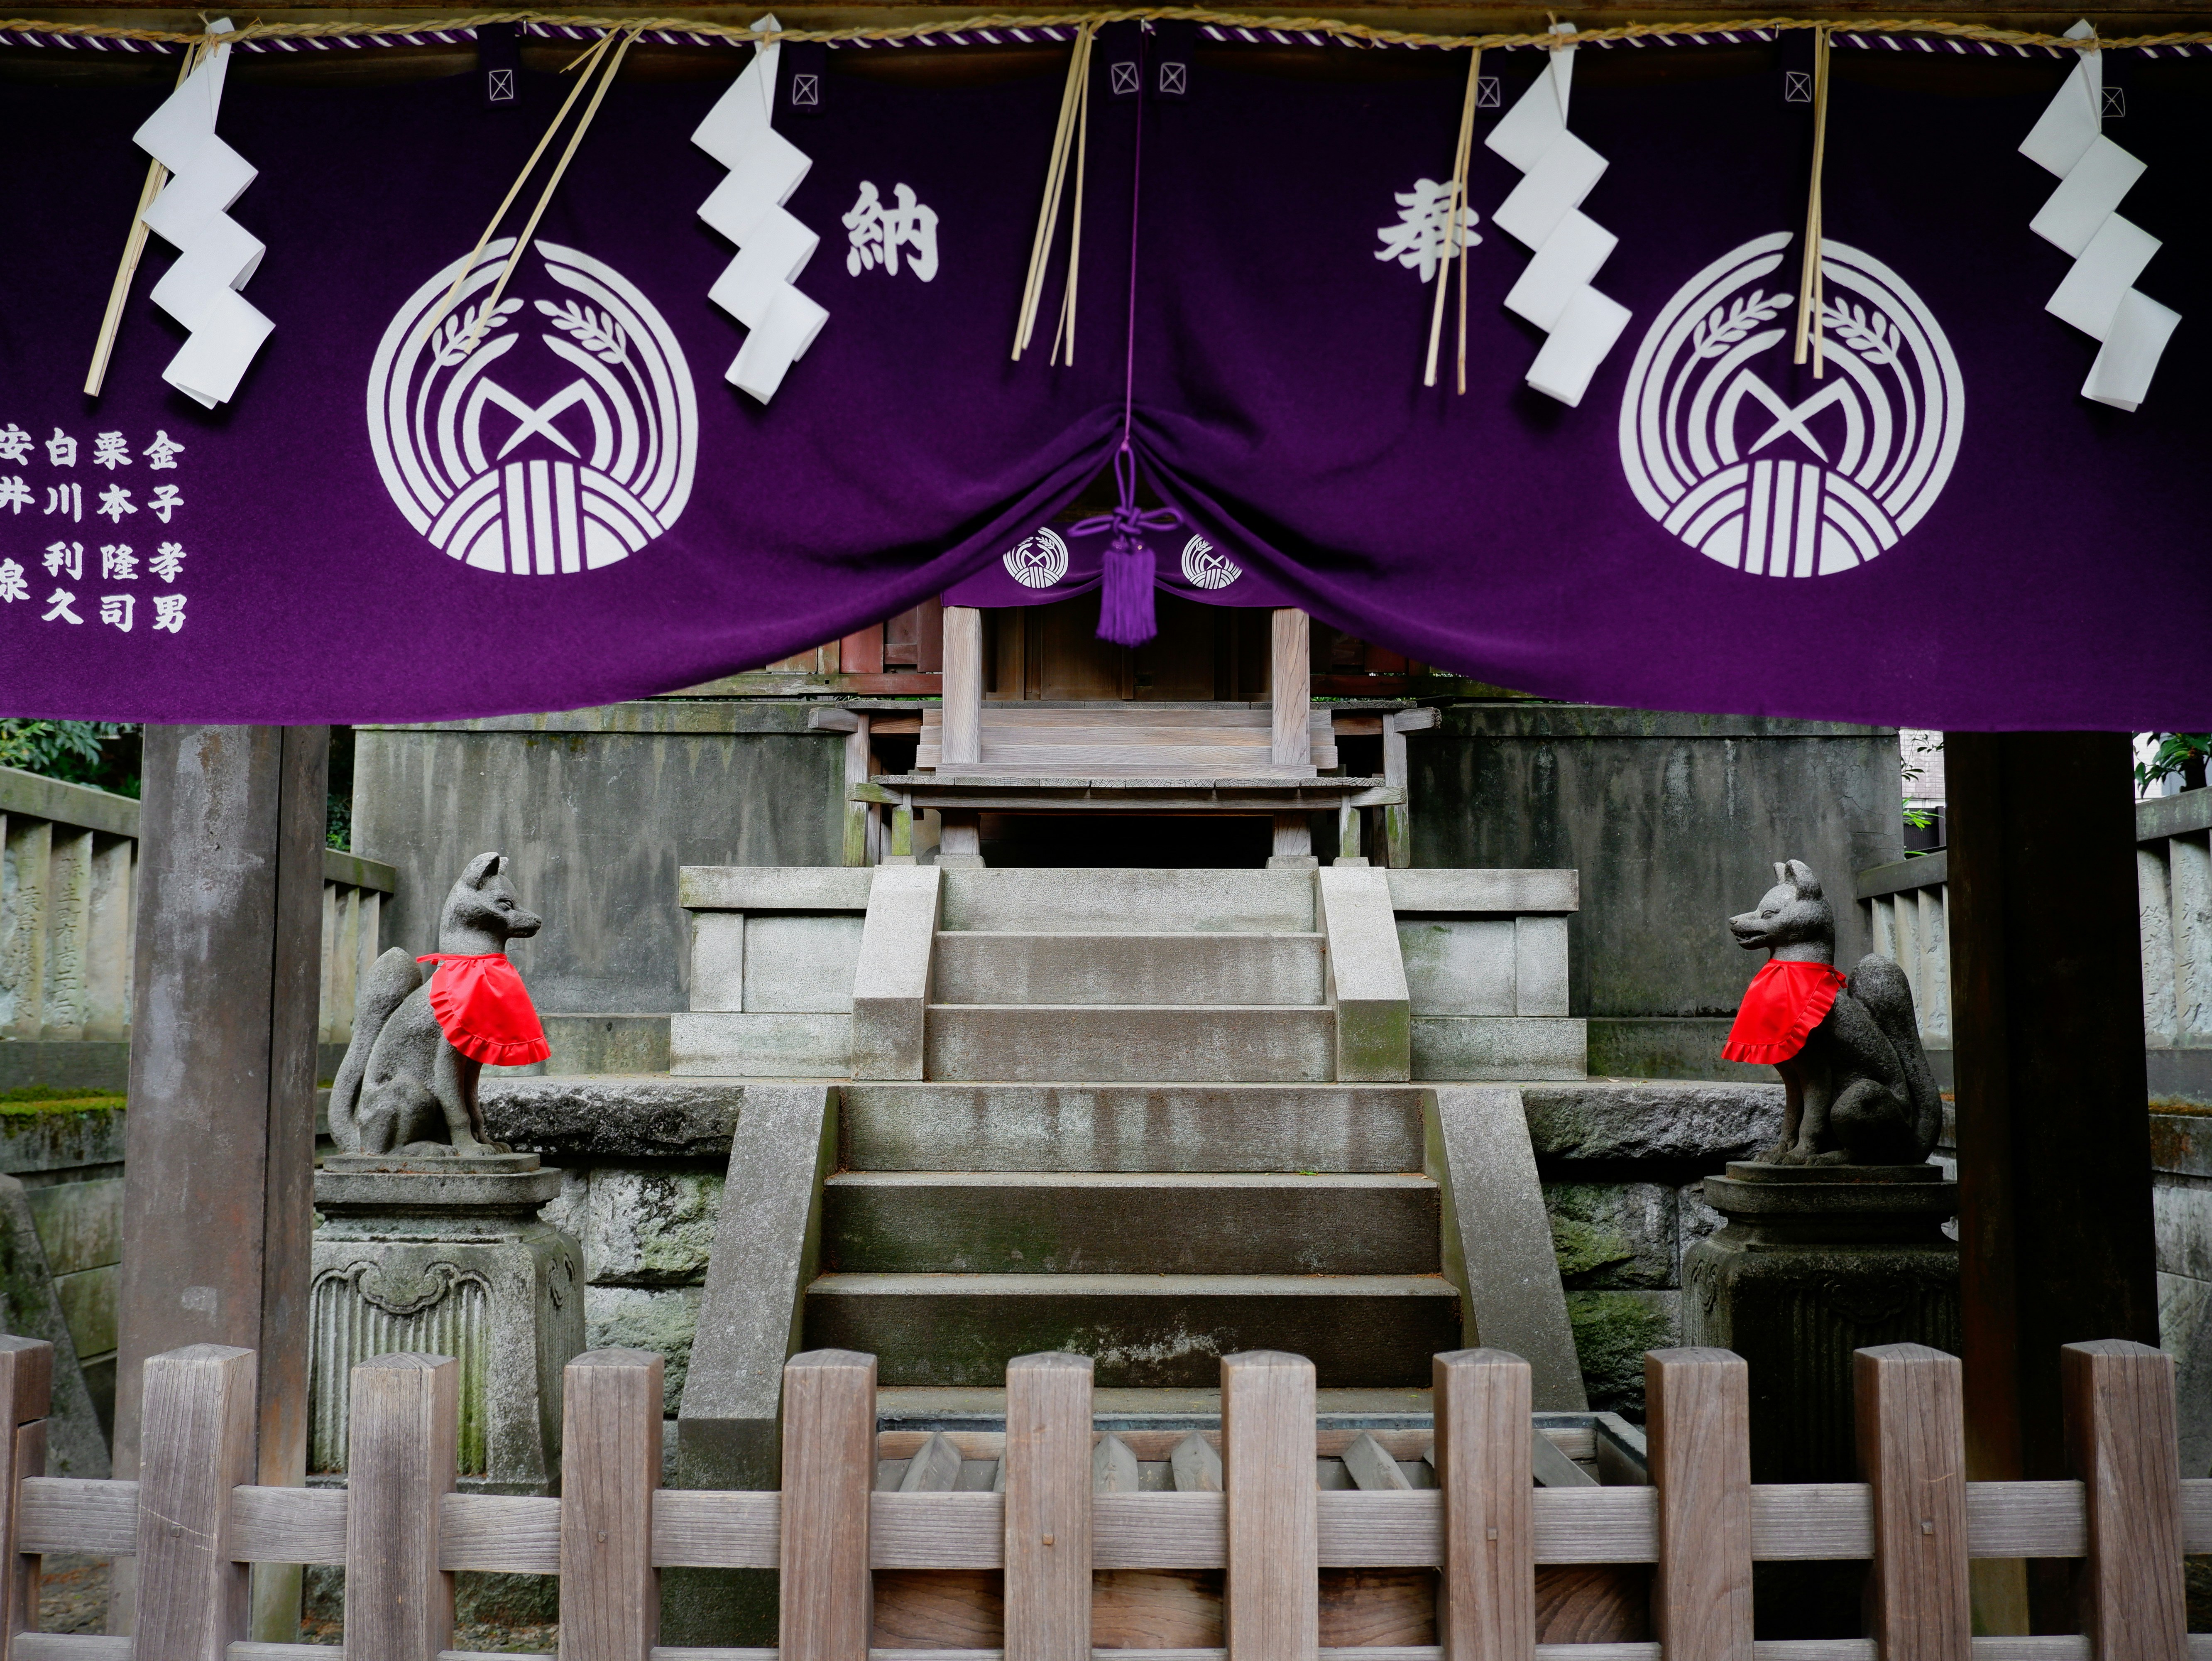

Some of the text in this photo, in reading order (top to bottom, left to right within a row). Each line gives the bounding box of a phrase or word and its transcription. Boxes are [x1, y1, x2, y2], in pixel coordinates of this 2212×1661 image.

[842, 180, 939, 282] 納
[1373, 178, 1483, 284] 奉
[41, 427, 84, 625] 白川利久
[93, 431, 139, 633] 栗本隆司
[143, 430, 187, 634] 金子孝男
